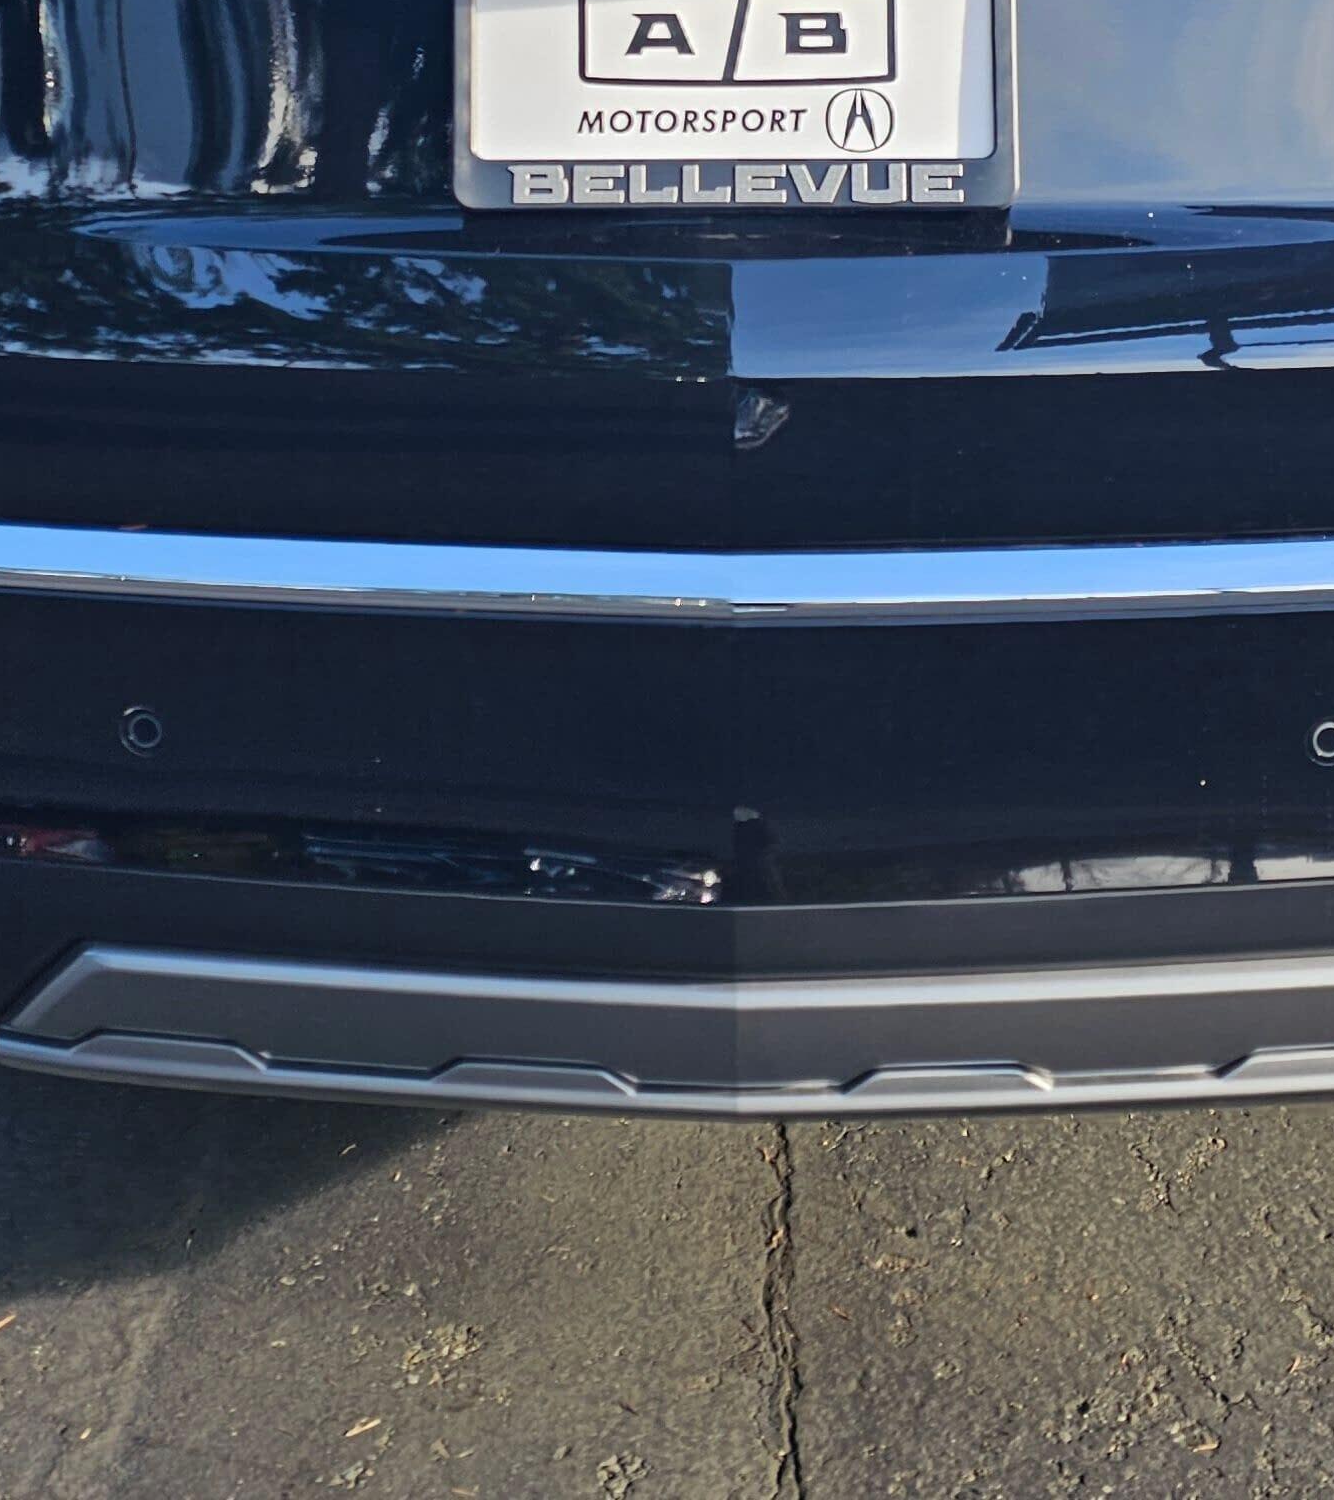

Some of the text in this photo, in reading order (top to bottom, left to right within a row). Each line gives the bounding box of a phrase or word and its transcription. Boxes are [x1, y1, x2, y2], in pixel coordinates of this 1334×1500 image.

[624, 12, 847, 55] A B
[577, 108, 809, 135] MOTORSPORT
[507, 162, 965, 204] BELLEVUE
